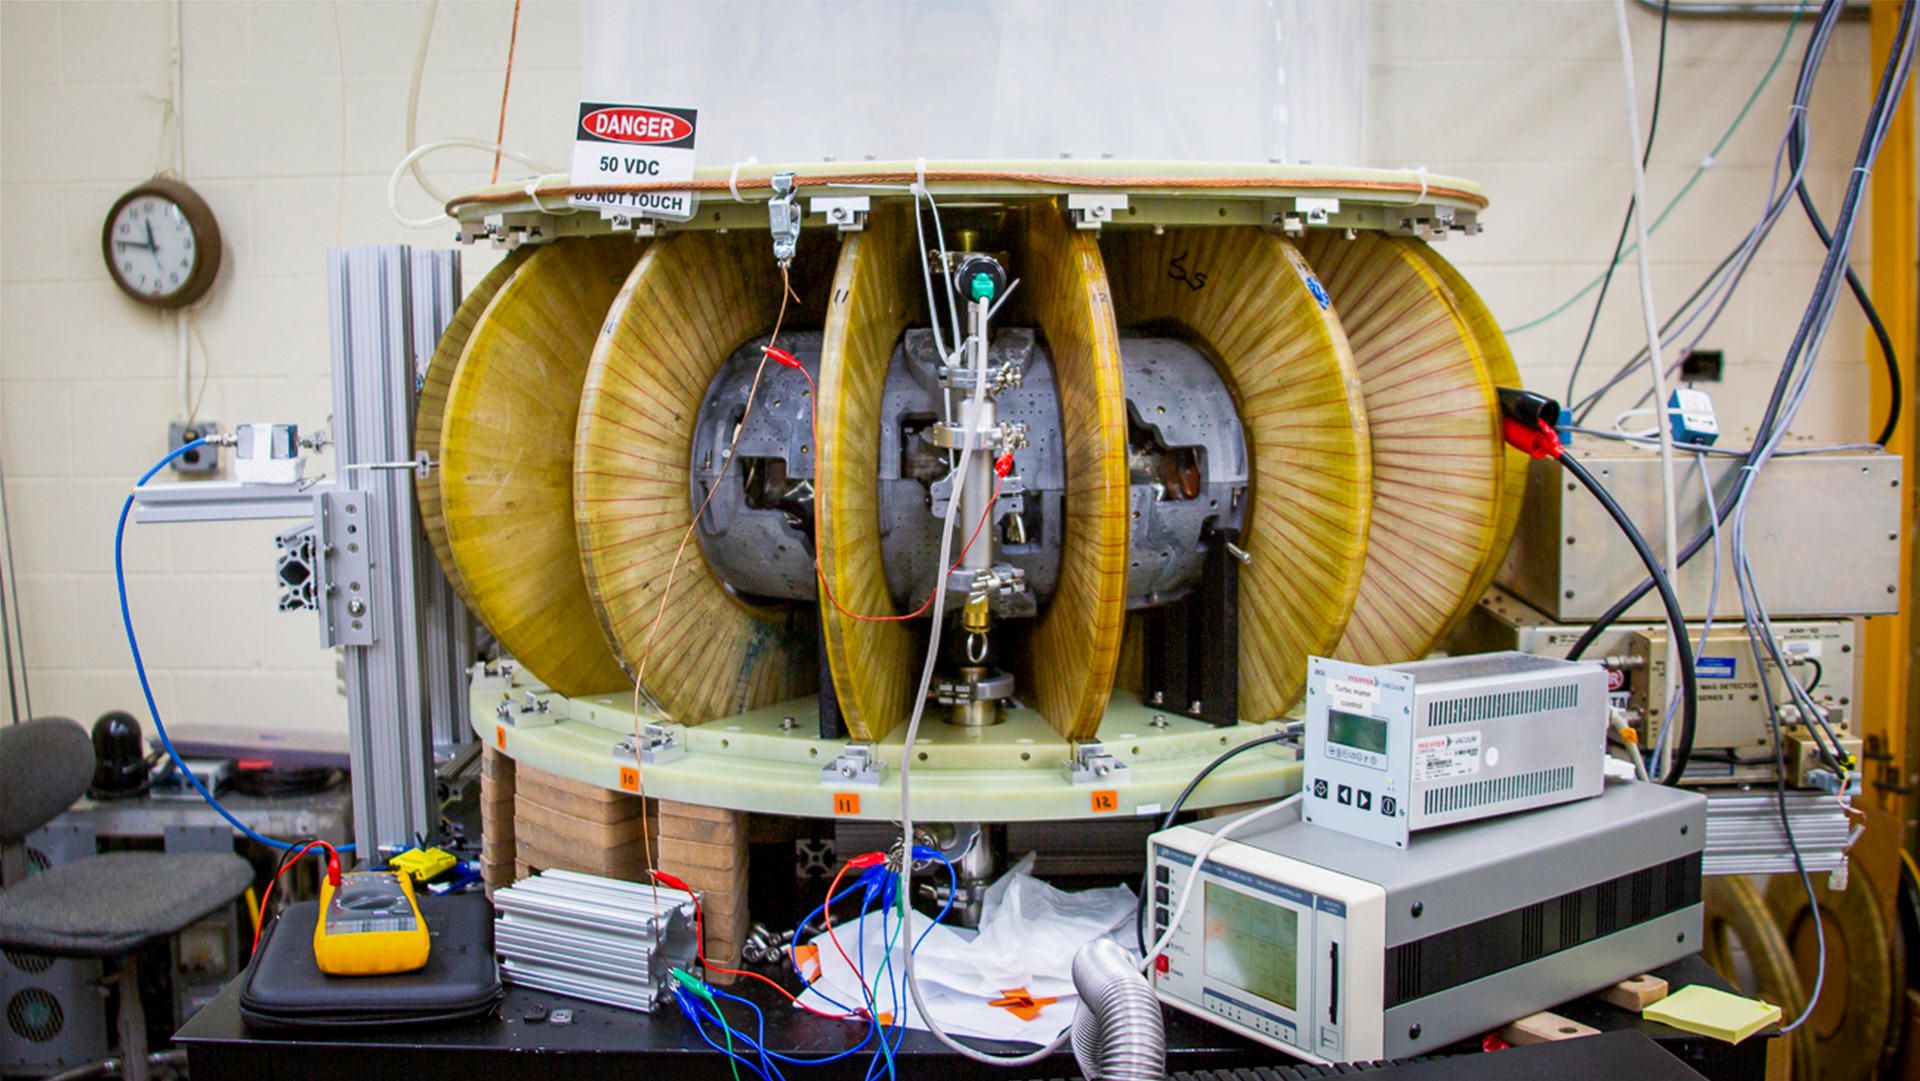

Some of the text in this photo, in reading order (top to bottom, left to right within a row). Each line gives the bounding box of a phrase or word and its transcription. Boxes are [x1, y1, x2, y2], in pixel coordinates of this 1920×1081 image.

[595, 112, 675, 138] DANGER
[600, 156, 660, 176] 50 VDC
[575, 192, 682, 210] DO NOT TOUCH
[1719, 682, 1759, 690] DETECTOR
[623, 772, 634, 786] 10
[839, 799, 851, 813] 11
[1095, 795, 1112, 809] 12
